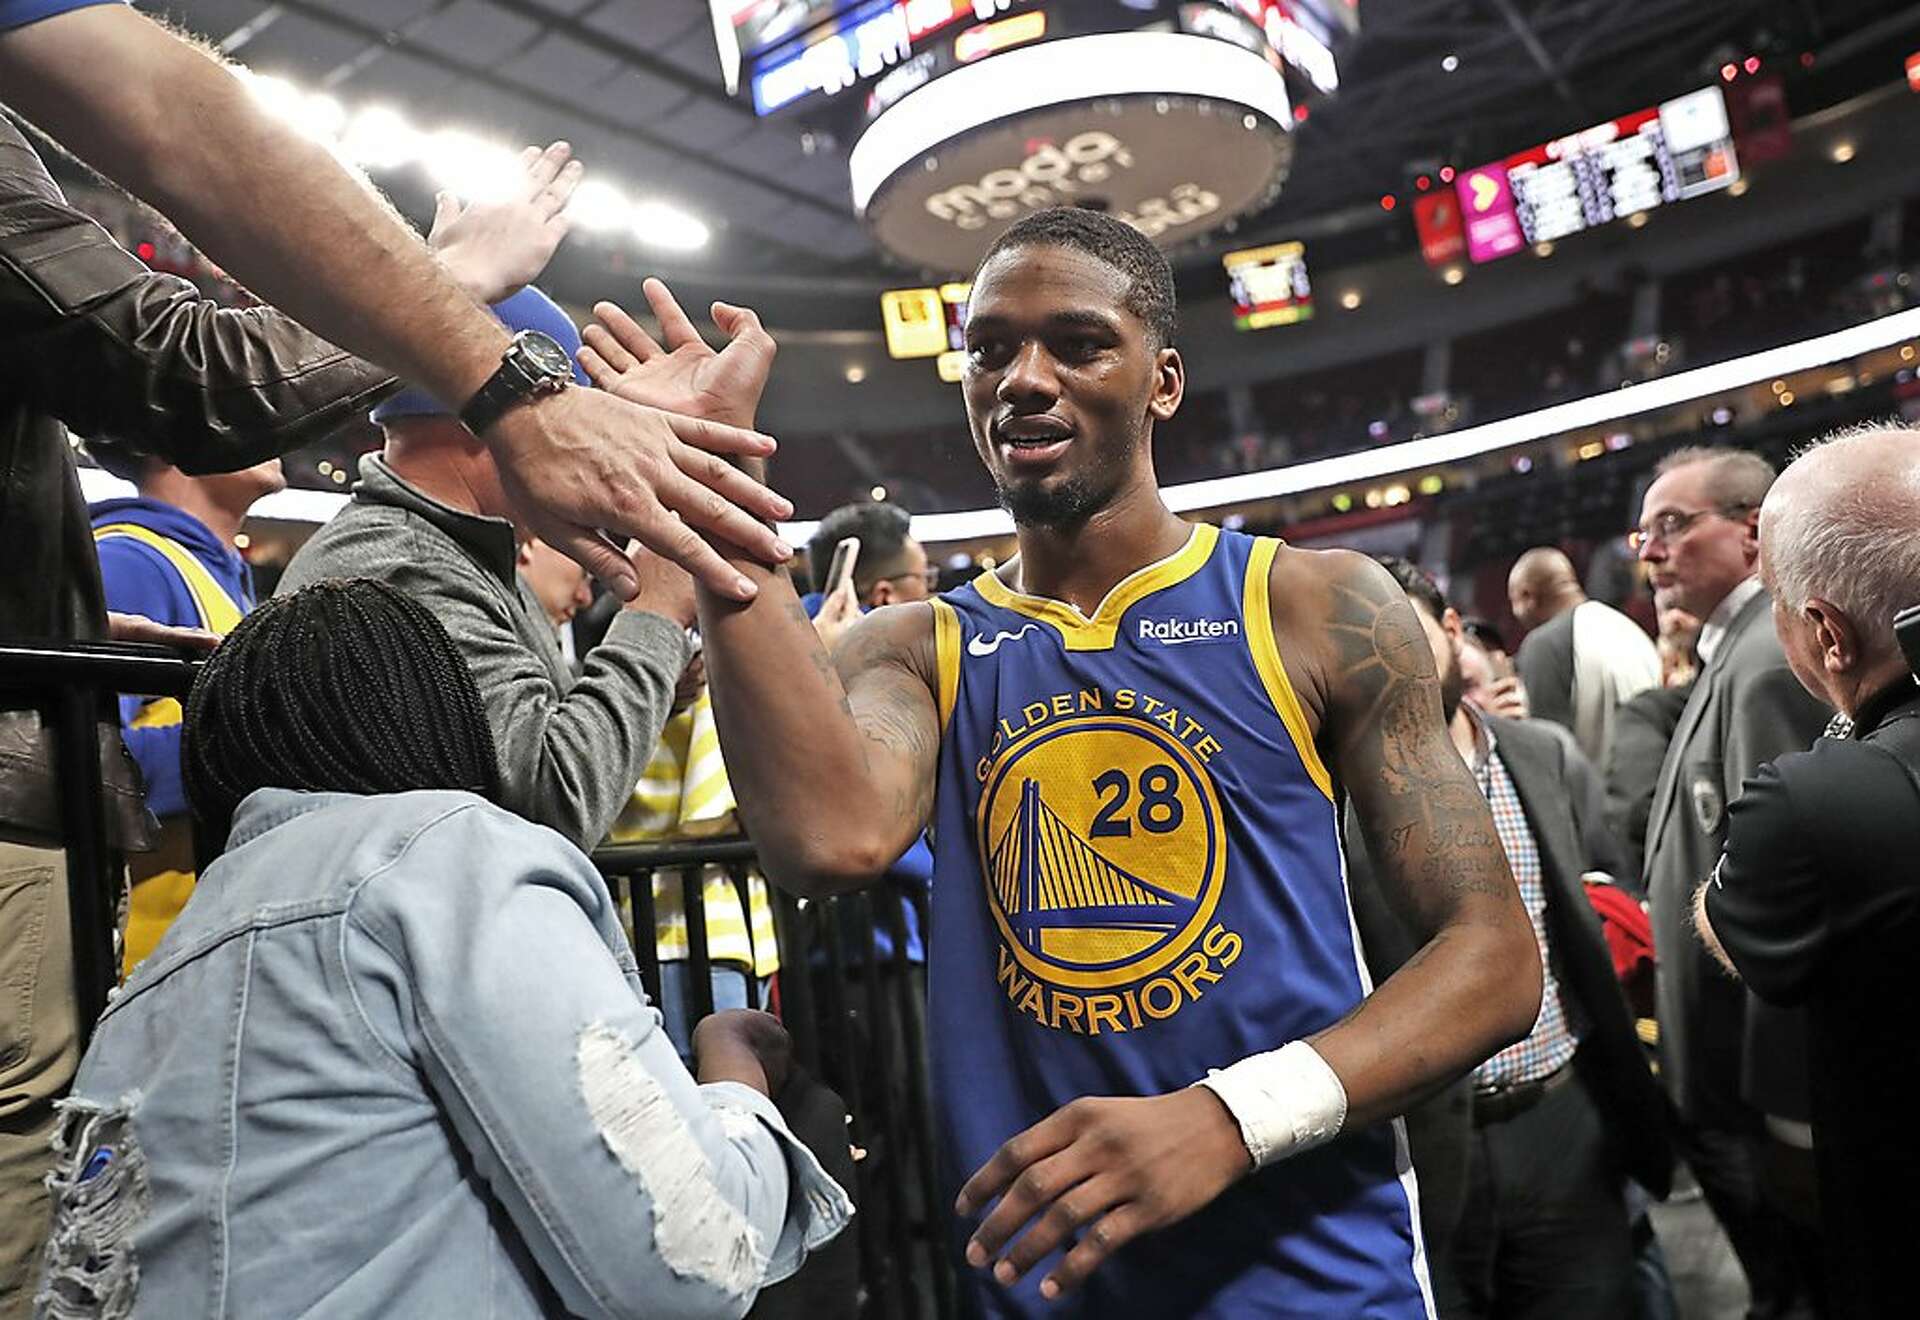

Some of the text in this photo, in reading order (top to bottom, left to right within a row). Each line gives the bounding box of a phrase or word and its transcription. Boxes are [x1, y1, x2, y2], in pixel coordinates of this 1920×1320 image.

[925, 130, 1123, 221] moda
[1139, 618, 1239, 645] Rakuten
[1114, 688, 1224, 763] STATE
[1088, 764, 1184, 840] 28
[997, 922, 1243, 1036] WARRIORS
